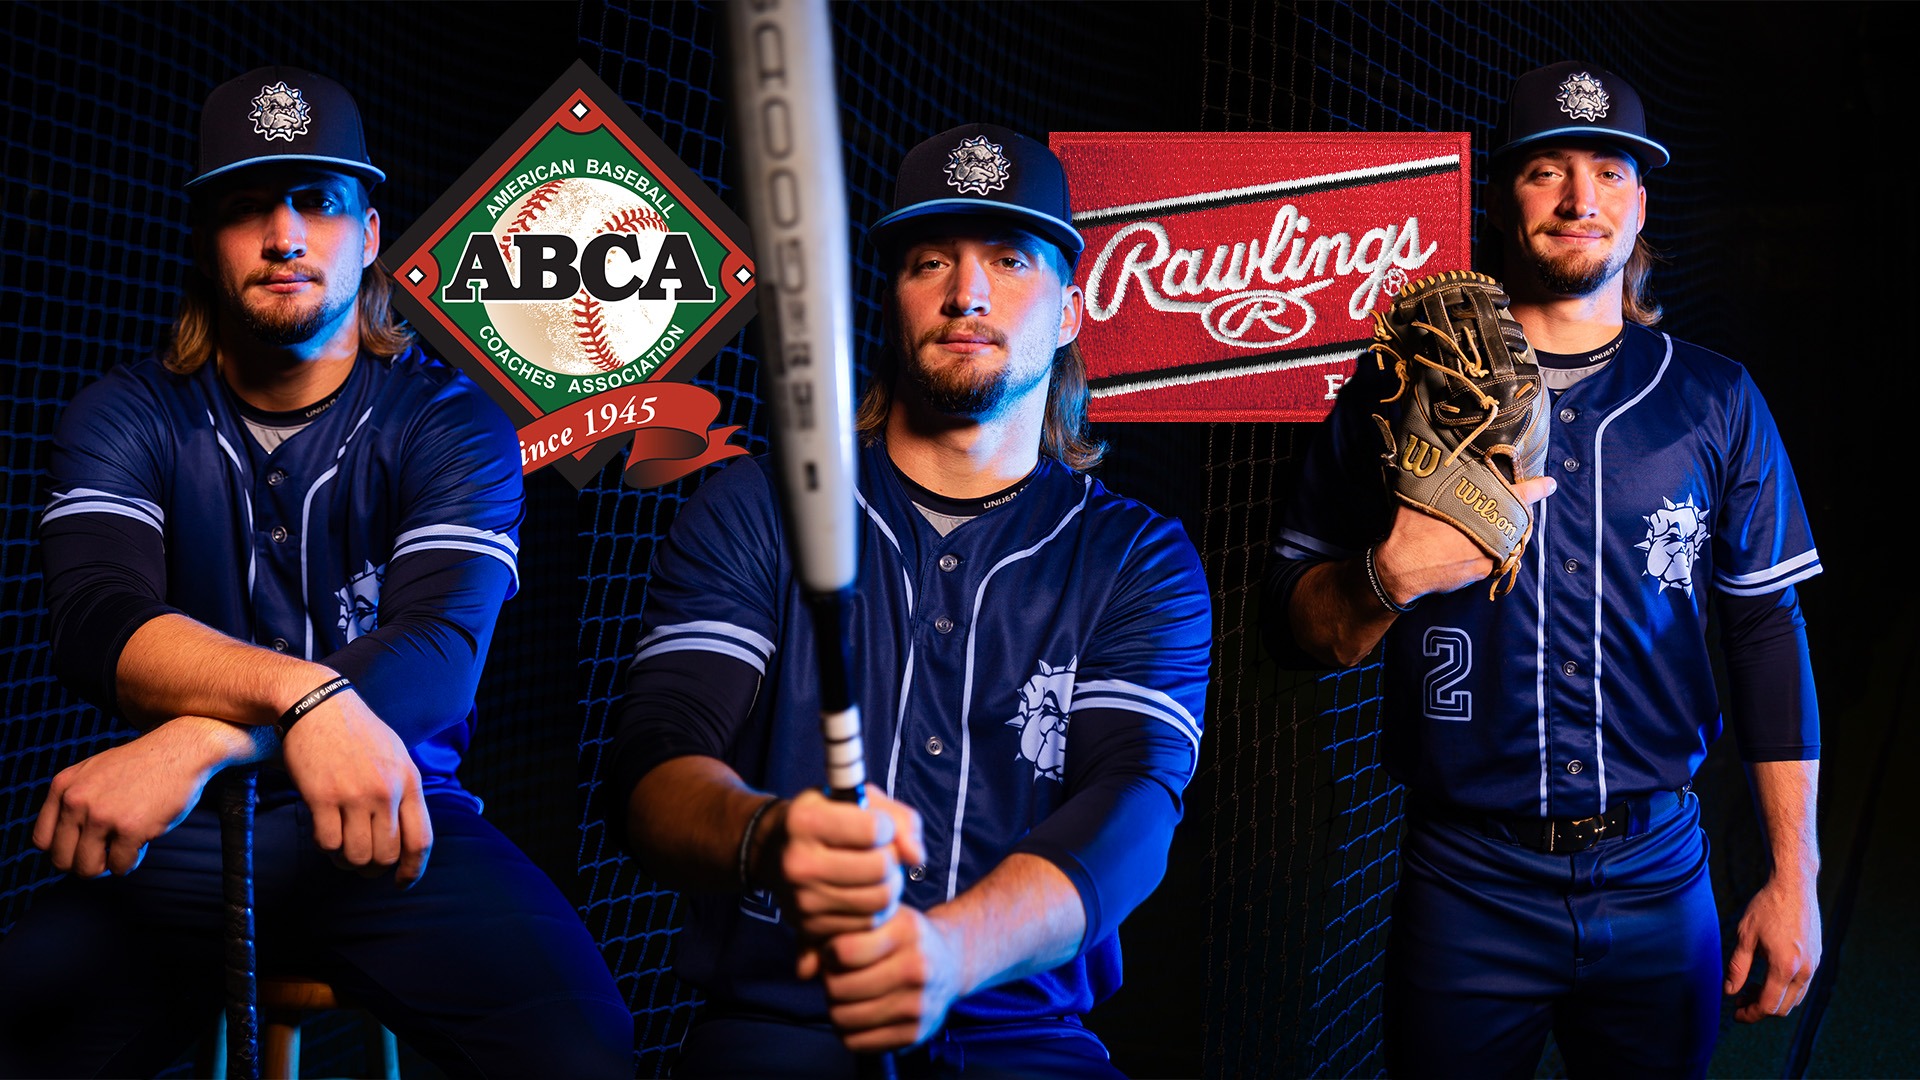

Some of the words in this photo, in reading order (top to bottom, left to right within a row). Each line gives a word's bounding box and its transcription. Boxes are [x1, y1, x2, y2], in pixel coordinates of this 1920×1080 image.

[1401, 433, 1442, 478] W
[1453, 475, 1518, 541] Wilson
[314, 691, 321, 700] A
[1423, 625, 1473, 721] 2
[294, 697, 316, 715] WOLF
